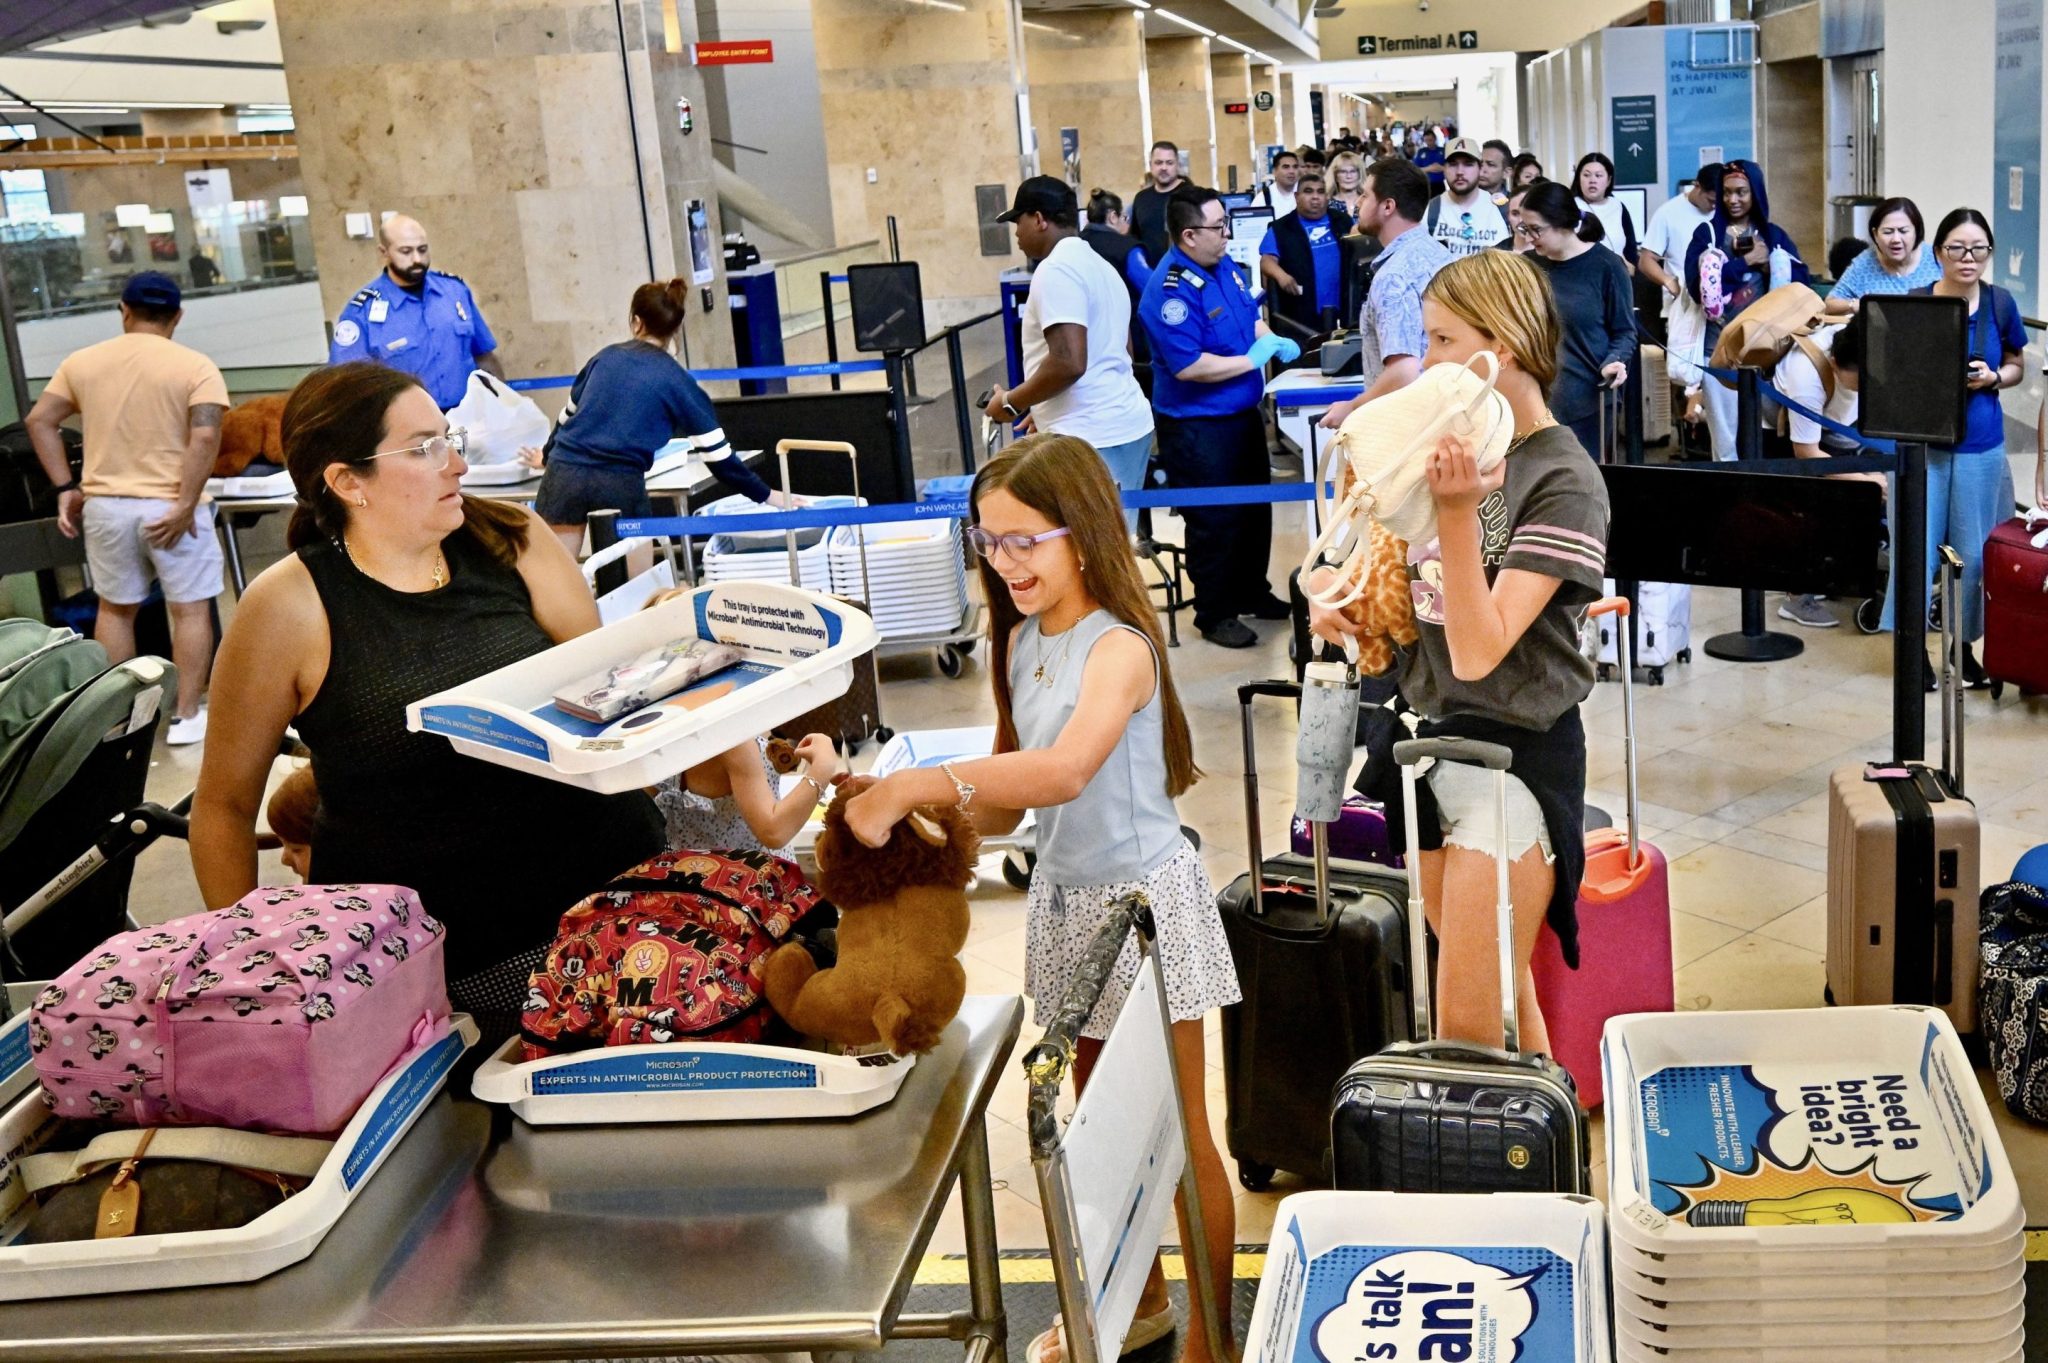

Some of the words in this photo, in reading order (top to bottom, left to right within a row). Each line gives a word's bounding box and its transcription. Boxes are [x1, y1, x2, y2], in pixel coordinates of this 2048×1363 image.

[698, 50, 730, 58] EMPLOYEE
[730, 49, 750, 57] ENTRY
[750, 48, 769, 56] POINT
[1378, 34, 1442, 51] Terminal
[1446, 33, 1457, 48] A
[1671, 74, 1682, 82] IS
[1685, 71, 1748, 81] HAPPENING
[1671, 87, 1684, 95] AT
[1689, 85, 1717, 95] JWA!
[1454, 139, 1466, 150] A
[914, 505, 933, 514] JOHN
[933, 503, 956, 512] WAYNE
[958, 501, 969, 510] AIR
[616, 522, 641, 530] IRPORT
[1480, 491, 1510, 567] OUSE
[722, 599, 738, 611] This
[737, 601, 751, 615] tray
[751, 603, 757, 613] is
[757, 604, 789, 619] protected
[789, 608, 805, 620] with
[741, 615, 785, 631] Antimicrobial
[785, 622, 826, 640] Technology
[489, 729, 513, 742] PRODUCT
[513, 735, 545, 751] PROTECTION
[44, 854, 95, 901] mockingbird
[540, 1075, 587, 1085] EXPERTS
[603, 1072, 686, 1082] ANTIMICROBIAL
[688, 1071, 738, 1080] PRODUCT
[741, 1069, 807, 1079] PROTECTION
[1708, 1082, 1722, 1118] FRESHER
[1720, 1074, 1736, 1112] INNOVATE
[1872, 1075, 1921, 1132] Need
[346, 1147, 369, 1177] EXPERTS
[368, 1138, 375, 1150] IN
[374, 1097, 410, 1142] ANTIMICROBIAL
[409, 1070, 431, 1099] PRODUCT
[431, 1038, 459, 1072] PROTECTION
[1800, 1085, 1845, 1145] idea?
[1836, 1080, 1884, 1148] bright
[1727, 1111, 1739, 1133] WITH
[1714, 1117, 1729, 1160] PRODUCTS.
[1893, 1137, 1918, 1150] a
[6, 1144, 25, 1162] tray
[1361, 1269, 1405, 1329] talk
[1407, 1282, 1475, 1363] an!
[1480, 1304, 1488, 1321] WITH
[1478, 1321, 1487, 1360] SOLUTIONS
[1488, 1318, 1497, 1363] ECHNOLOGIES
